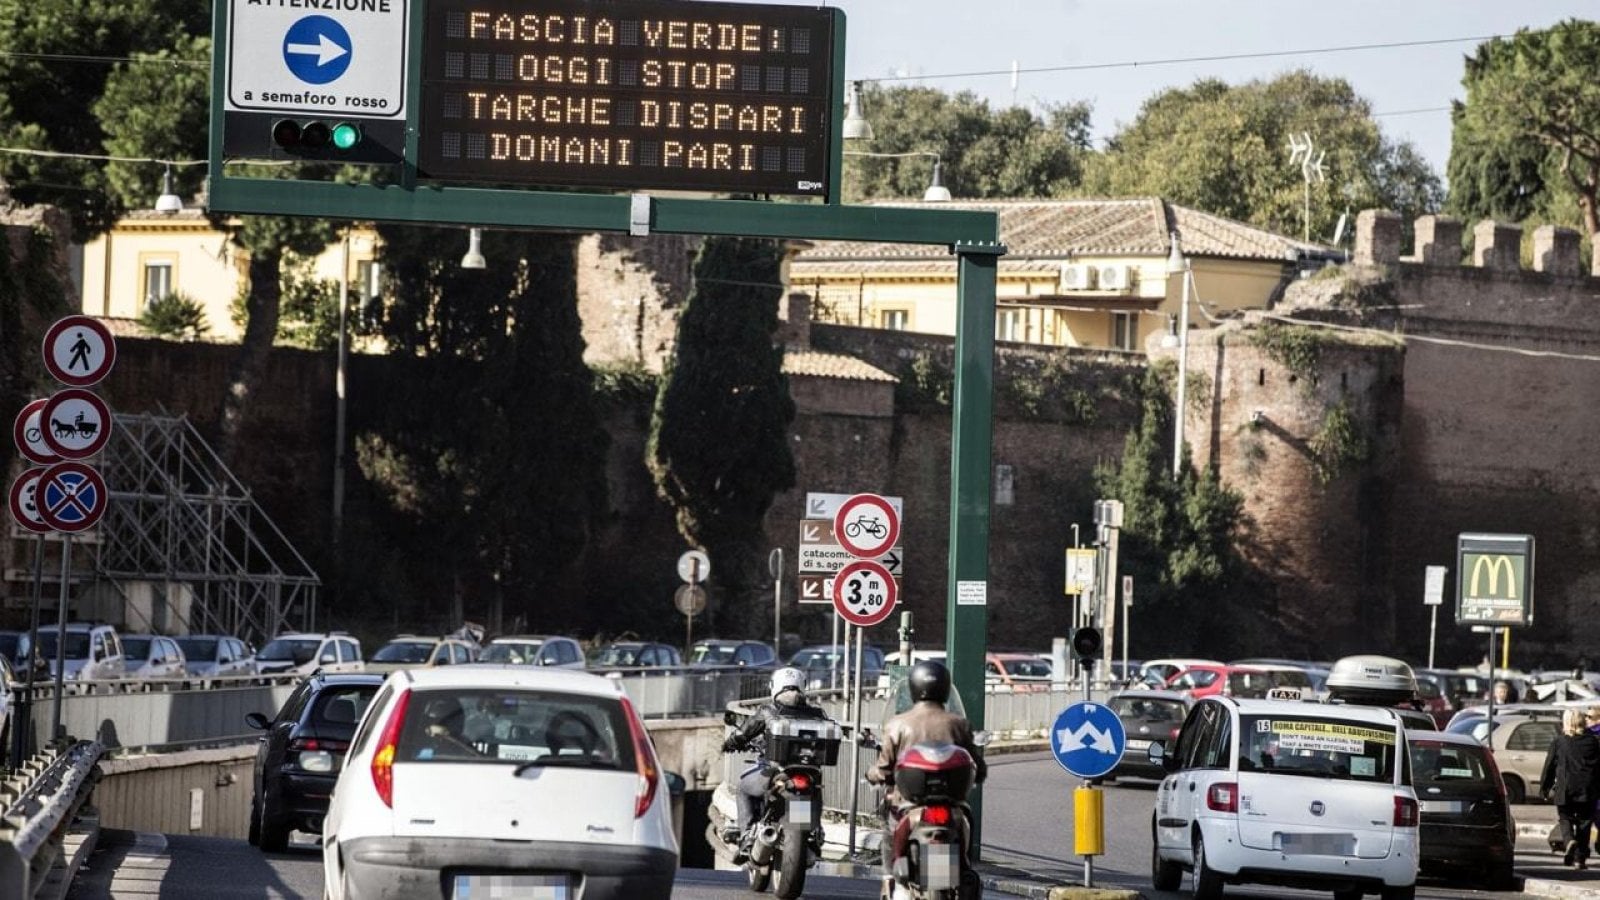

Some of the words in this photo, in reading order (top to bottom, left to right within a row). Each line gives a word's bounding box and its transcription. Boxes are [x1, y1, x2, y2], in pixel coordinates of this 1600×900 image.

[470, 12, 614, 45] FASCIA
[644, 20, 779, 51] VERDE:
[519, 54, 609, 85] OGGI
[642, 60, 735, 90] STOP
[244, 91, 253, 101] a
[262, 91, 336, 105] semaforo
[345, 97, 388, 109] rosso
[468, 92, 611, 125] TARGHE
[640, 100, 804, 133] DISPARI
[491, 133, 631, 166] DOMANI
[664, 141, 753, 171] PARI
[847, 579, 862, 605] 3
[869, 580, 879, 590] m
[1271, 690, 1300, 700] TAXI
[1258, 720, 1269, 731] 15
[1274, 722, 1294, 731] ROMA
